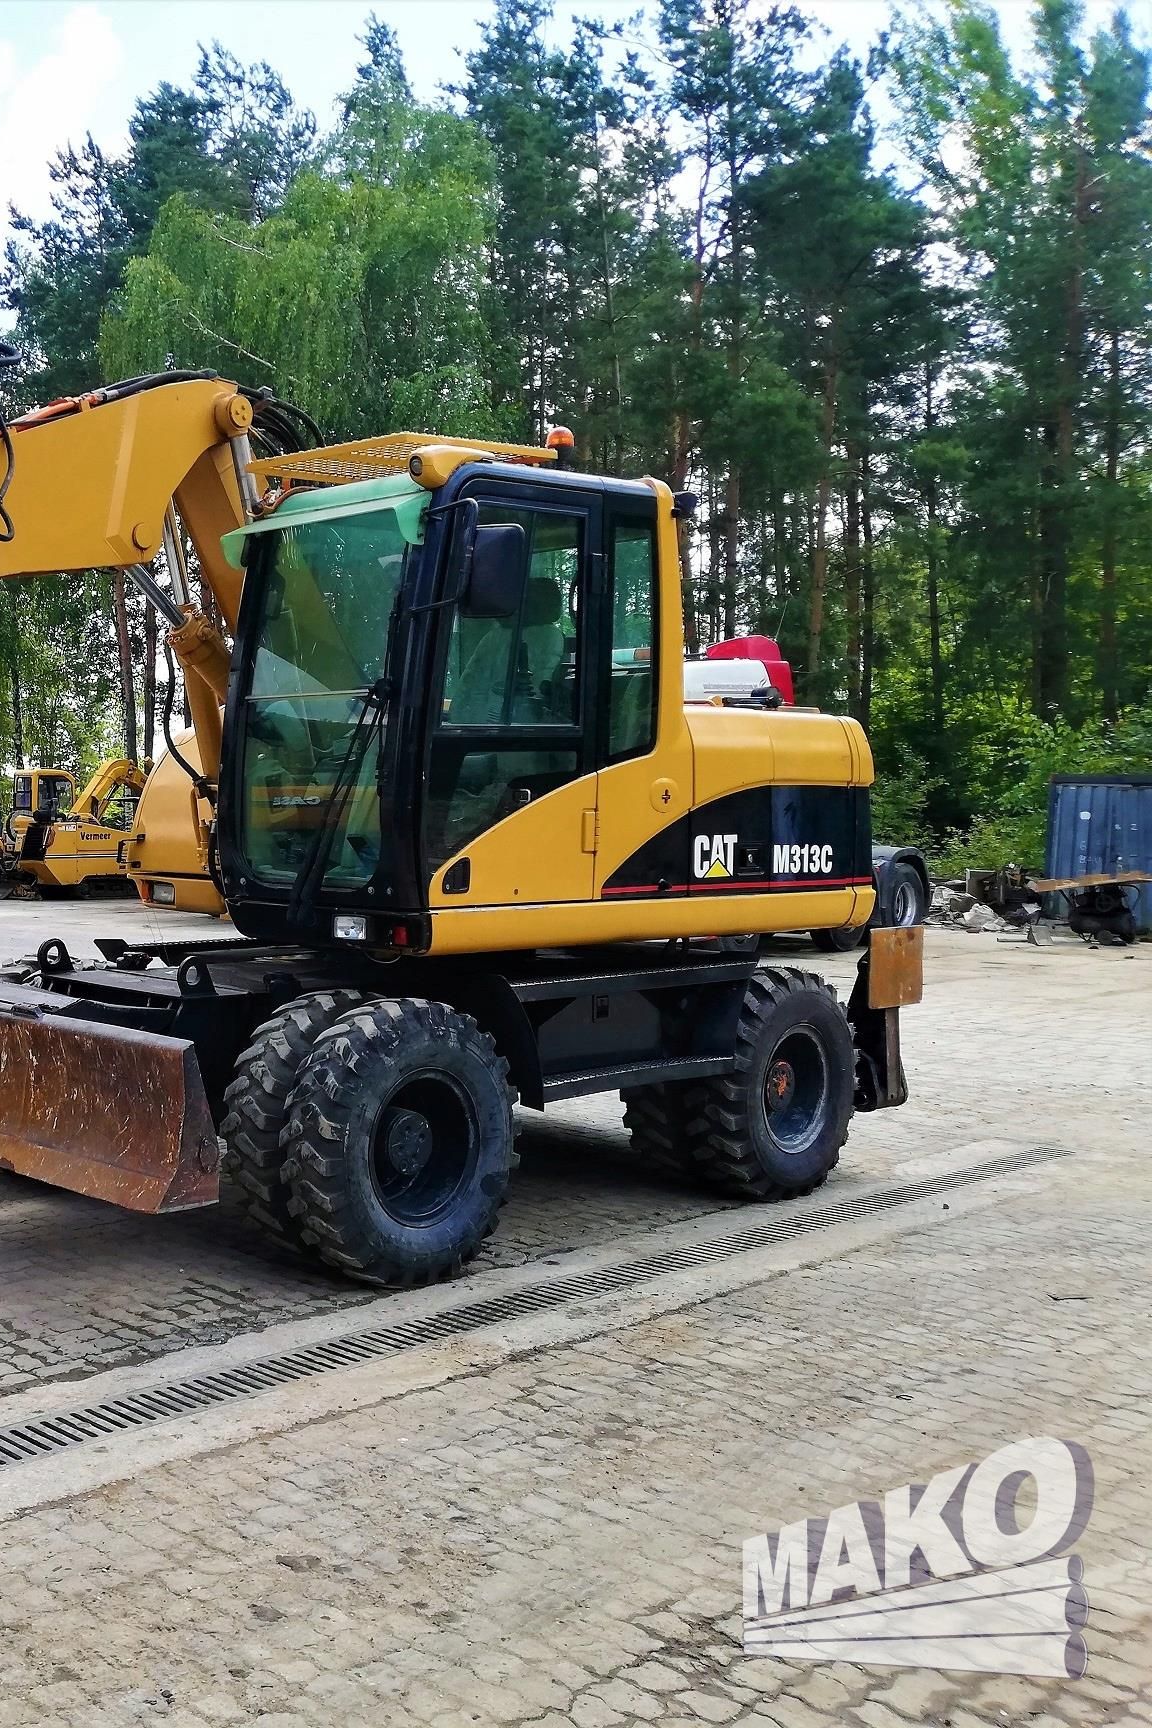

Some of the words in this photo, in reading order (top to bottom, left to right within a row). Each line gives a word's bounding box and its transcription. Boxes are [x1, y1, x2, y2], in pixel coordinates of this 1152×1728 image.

[80, 831, 111, 841] Vermeer
[694, 834, 738, 878] CAT
[773, 843, 833, 874] M313C
